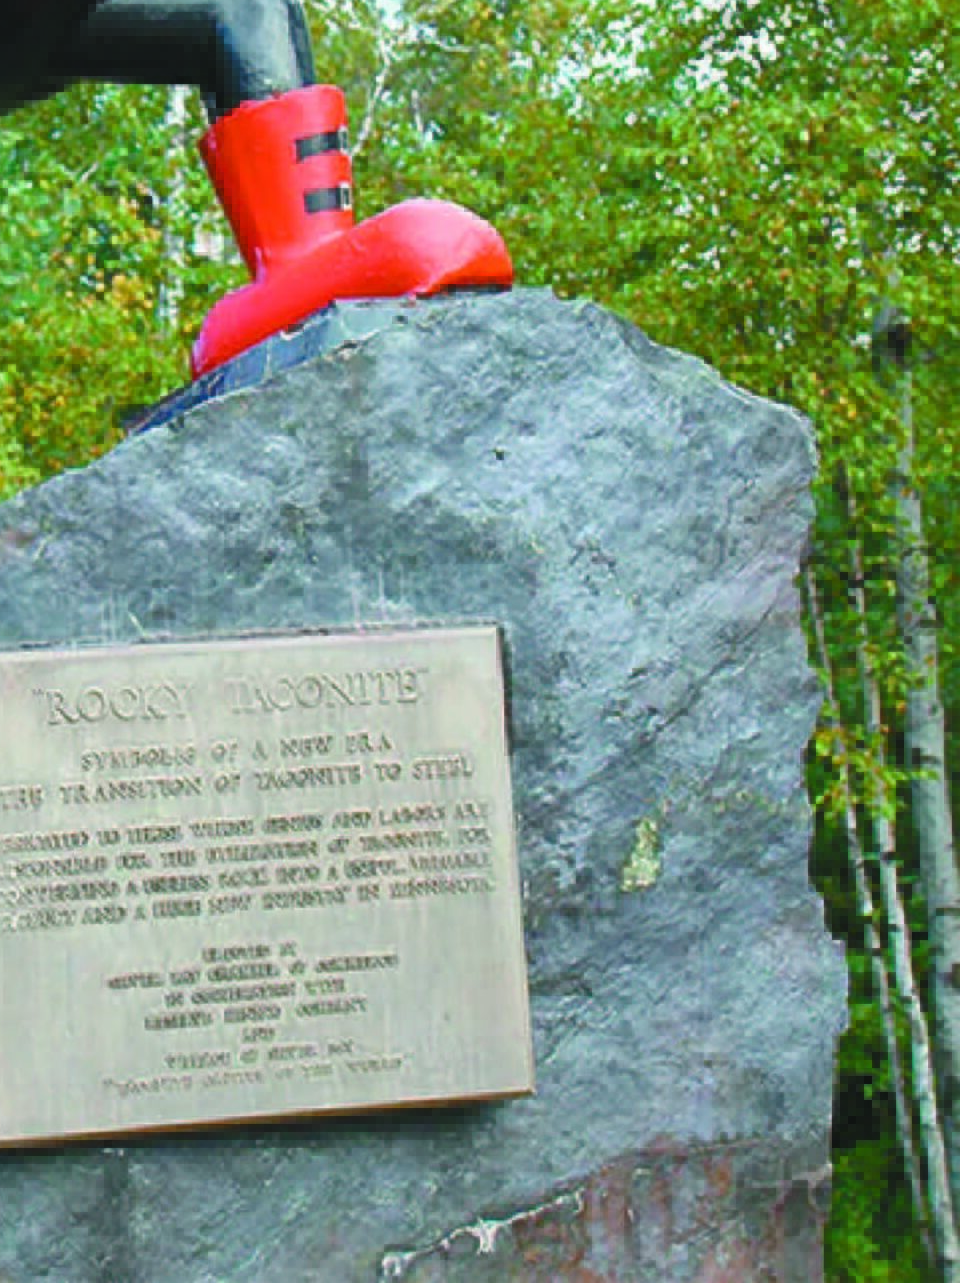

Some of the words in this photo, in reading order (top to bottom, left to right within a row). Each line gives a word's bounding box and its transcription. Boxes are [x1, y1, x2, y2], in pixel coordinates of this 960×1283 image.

[211, 742, 238, 760] OF
[252, 740, 268, 759] A
[280, 735, 334, 758] NEW
[345, 731, 392, 753] ERA
[60, 775, 202, 803] TRANSITION
[214, 773, 239, 793] OF
[376, 762, 401, 780] TO
